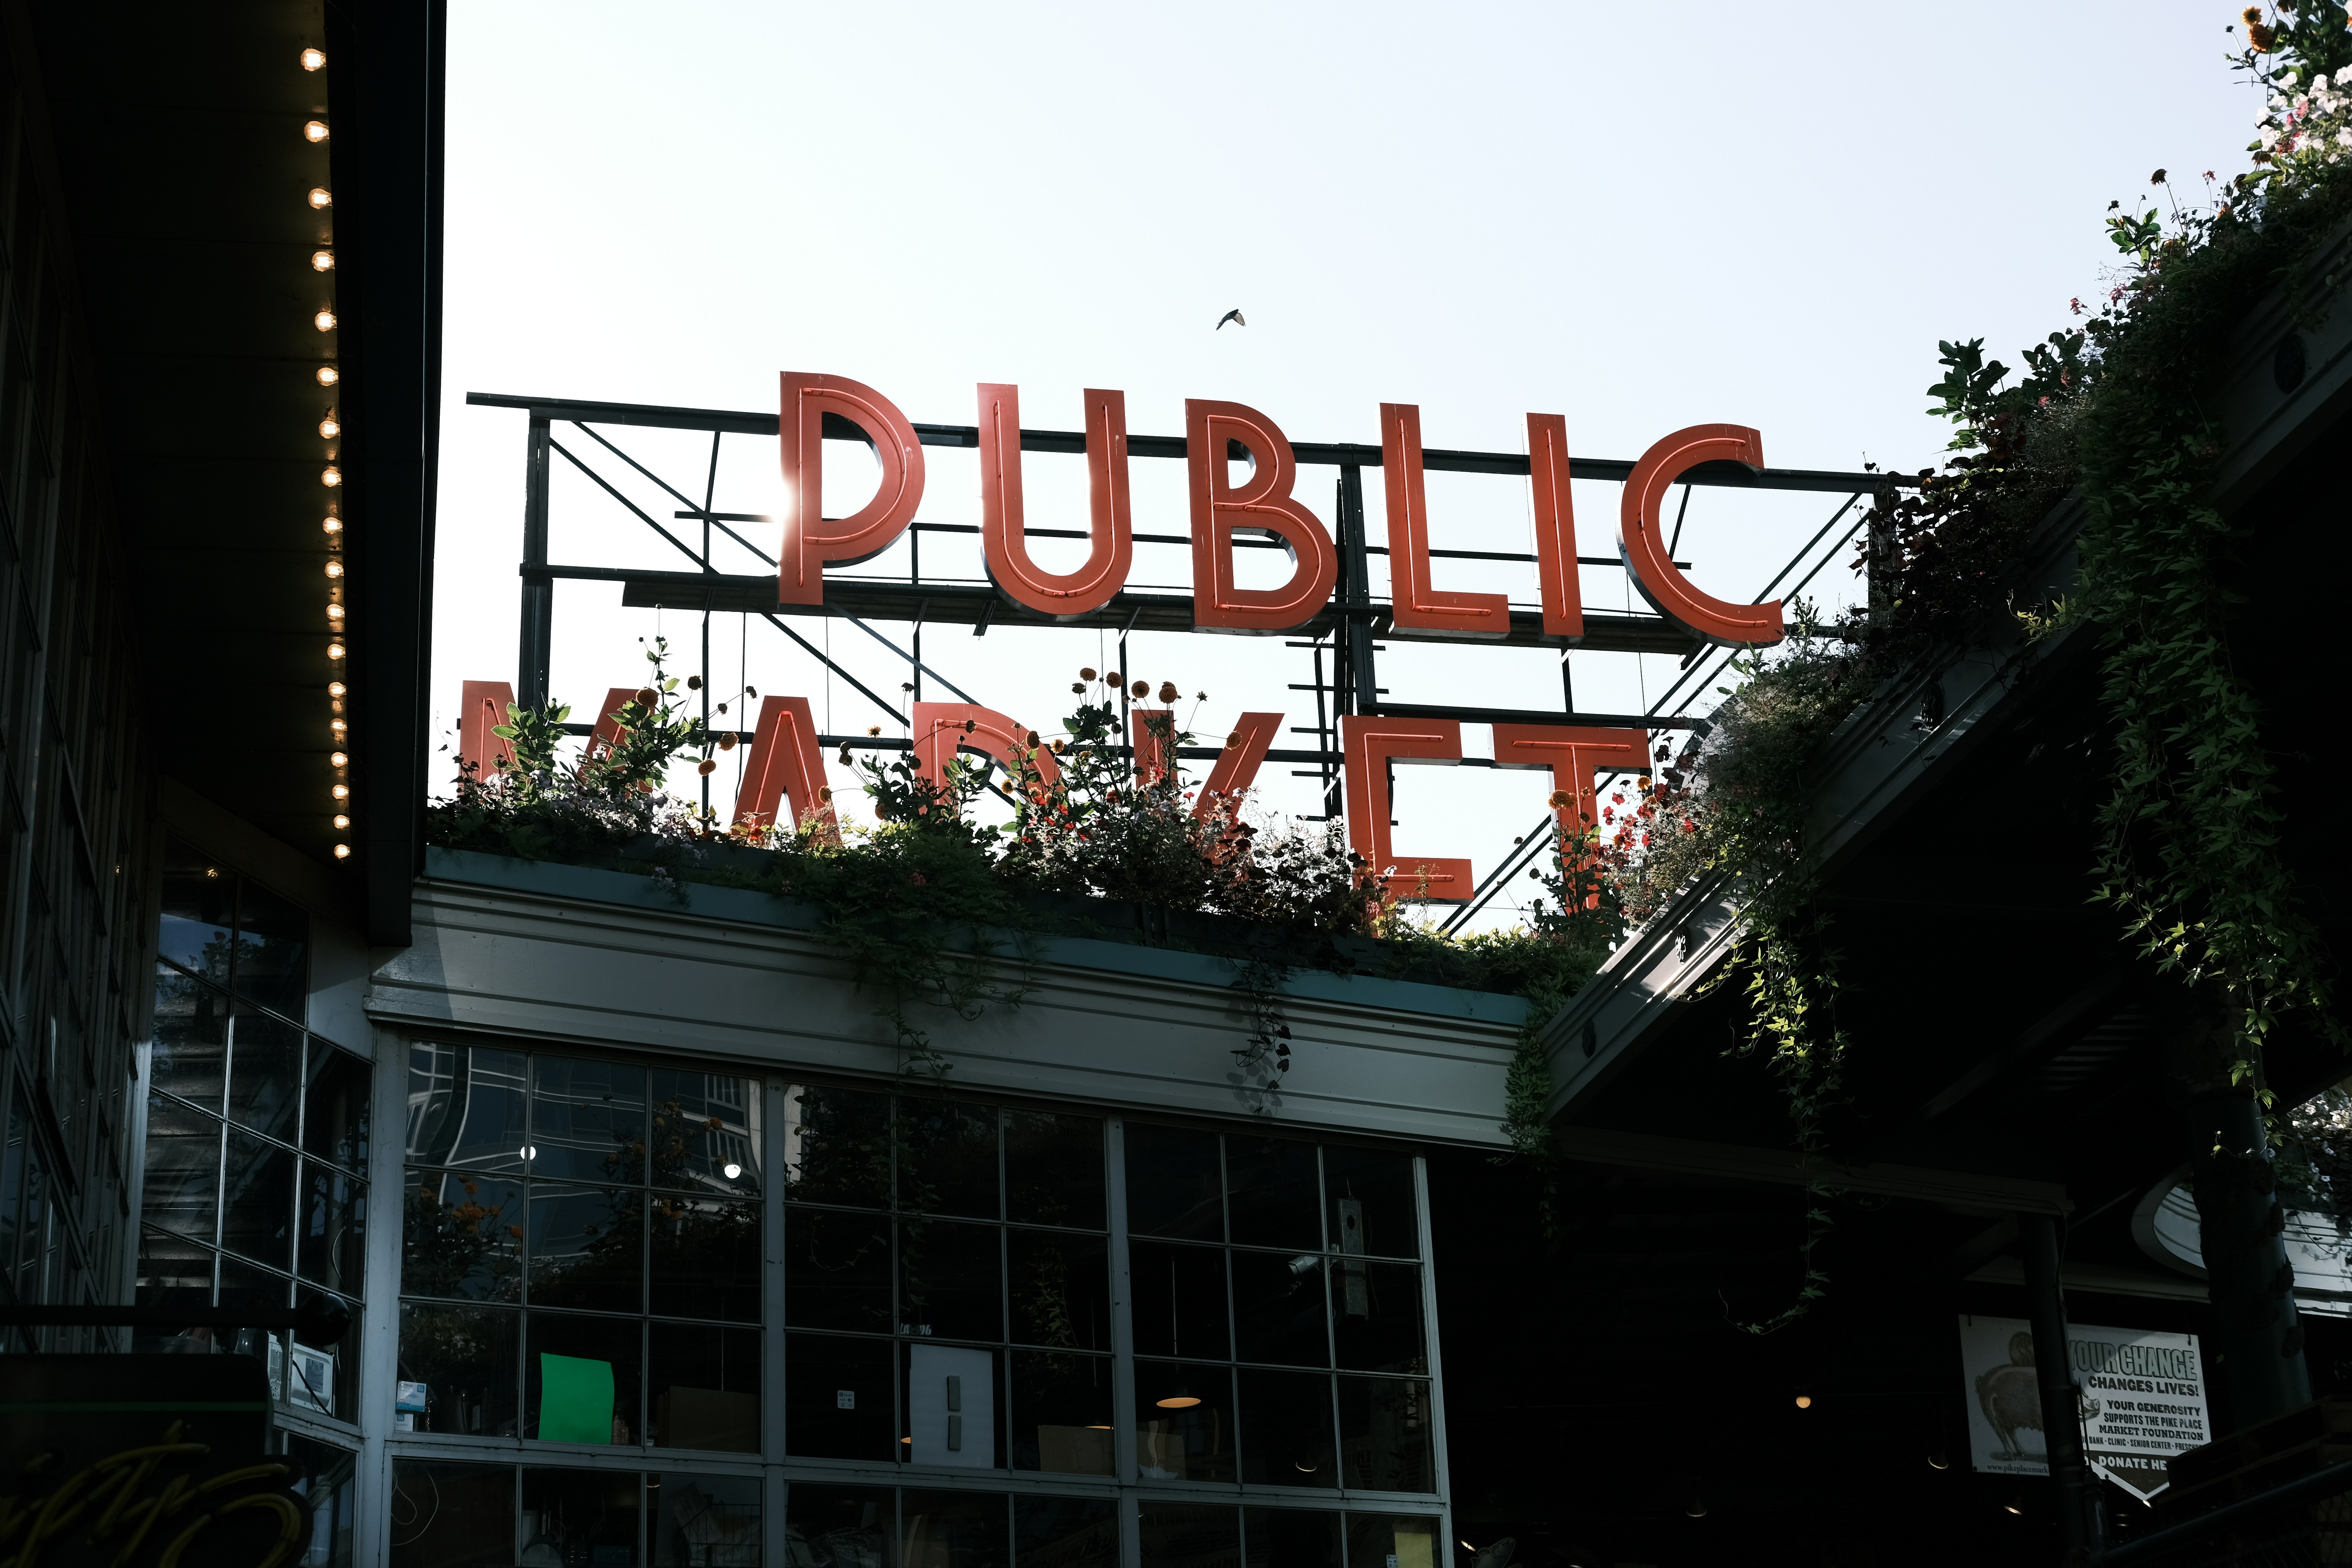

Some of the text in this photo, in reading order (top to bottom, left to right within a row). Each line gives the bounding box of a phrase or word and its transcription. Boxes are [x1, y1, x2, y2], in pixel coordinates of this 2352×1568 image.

[779, 370, 1784, 649] PUBLIC
[899, 1323, 910, 1335] LA
[2118, 1344, 2197, 1380] CHANGE
[2088, 1376, 2199, 1396] CHANGES LIVES!
[2107, 1400, 2200, 1416] YOUR GENEROSITY
[2104, 1413, 2202, 1429] SUPPORTS THE PIKE PLACE
[2099, 1425, 2203, 1441] MARKET FOUNDATION
[2089, 1436, 2104, 1444] BANK
[2108, 1438, 2126, 1446] CLINIC
[2130, 1439, 2150, 1448] SENIOR
[2151, 1441, 2171, 1449] CENTER
[2174, 1442, 2202, 1451] PRESCHO
[2098, 1455, 2148, 1469] DONATE
